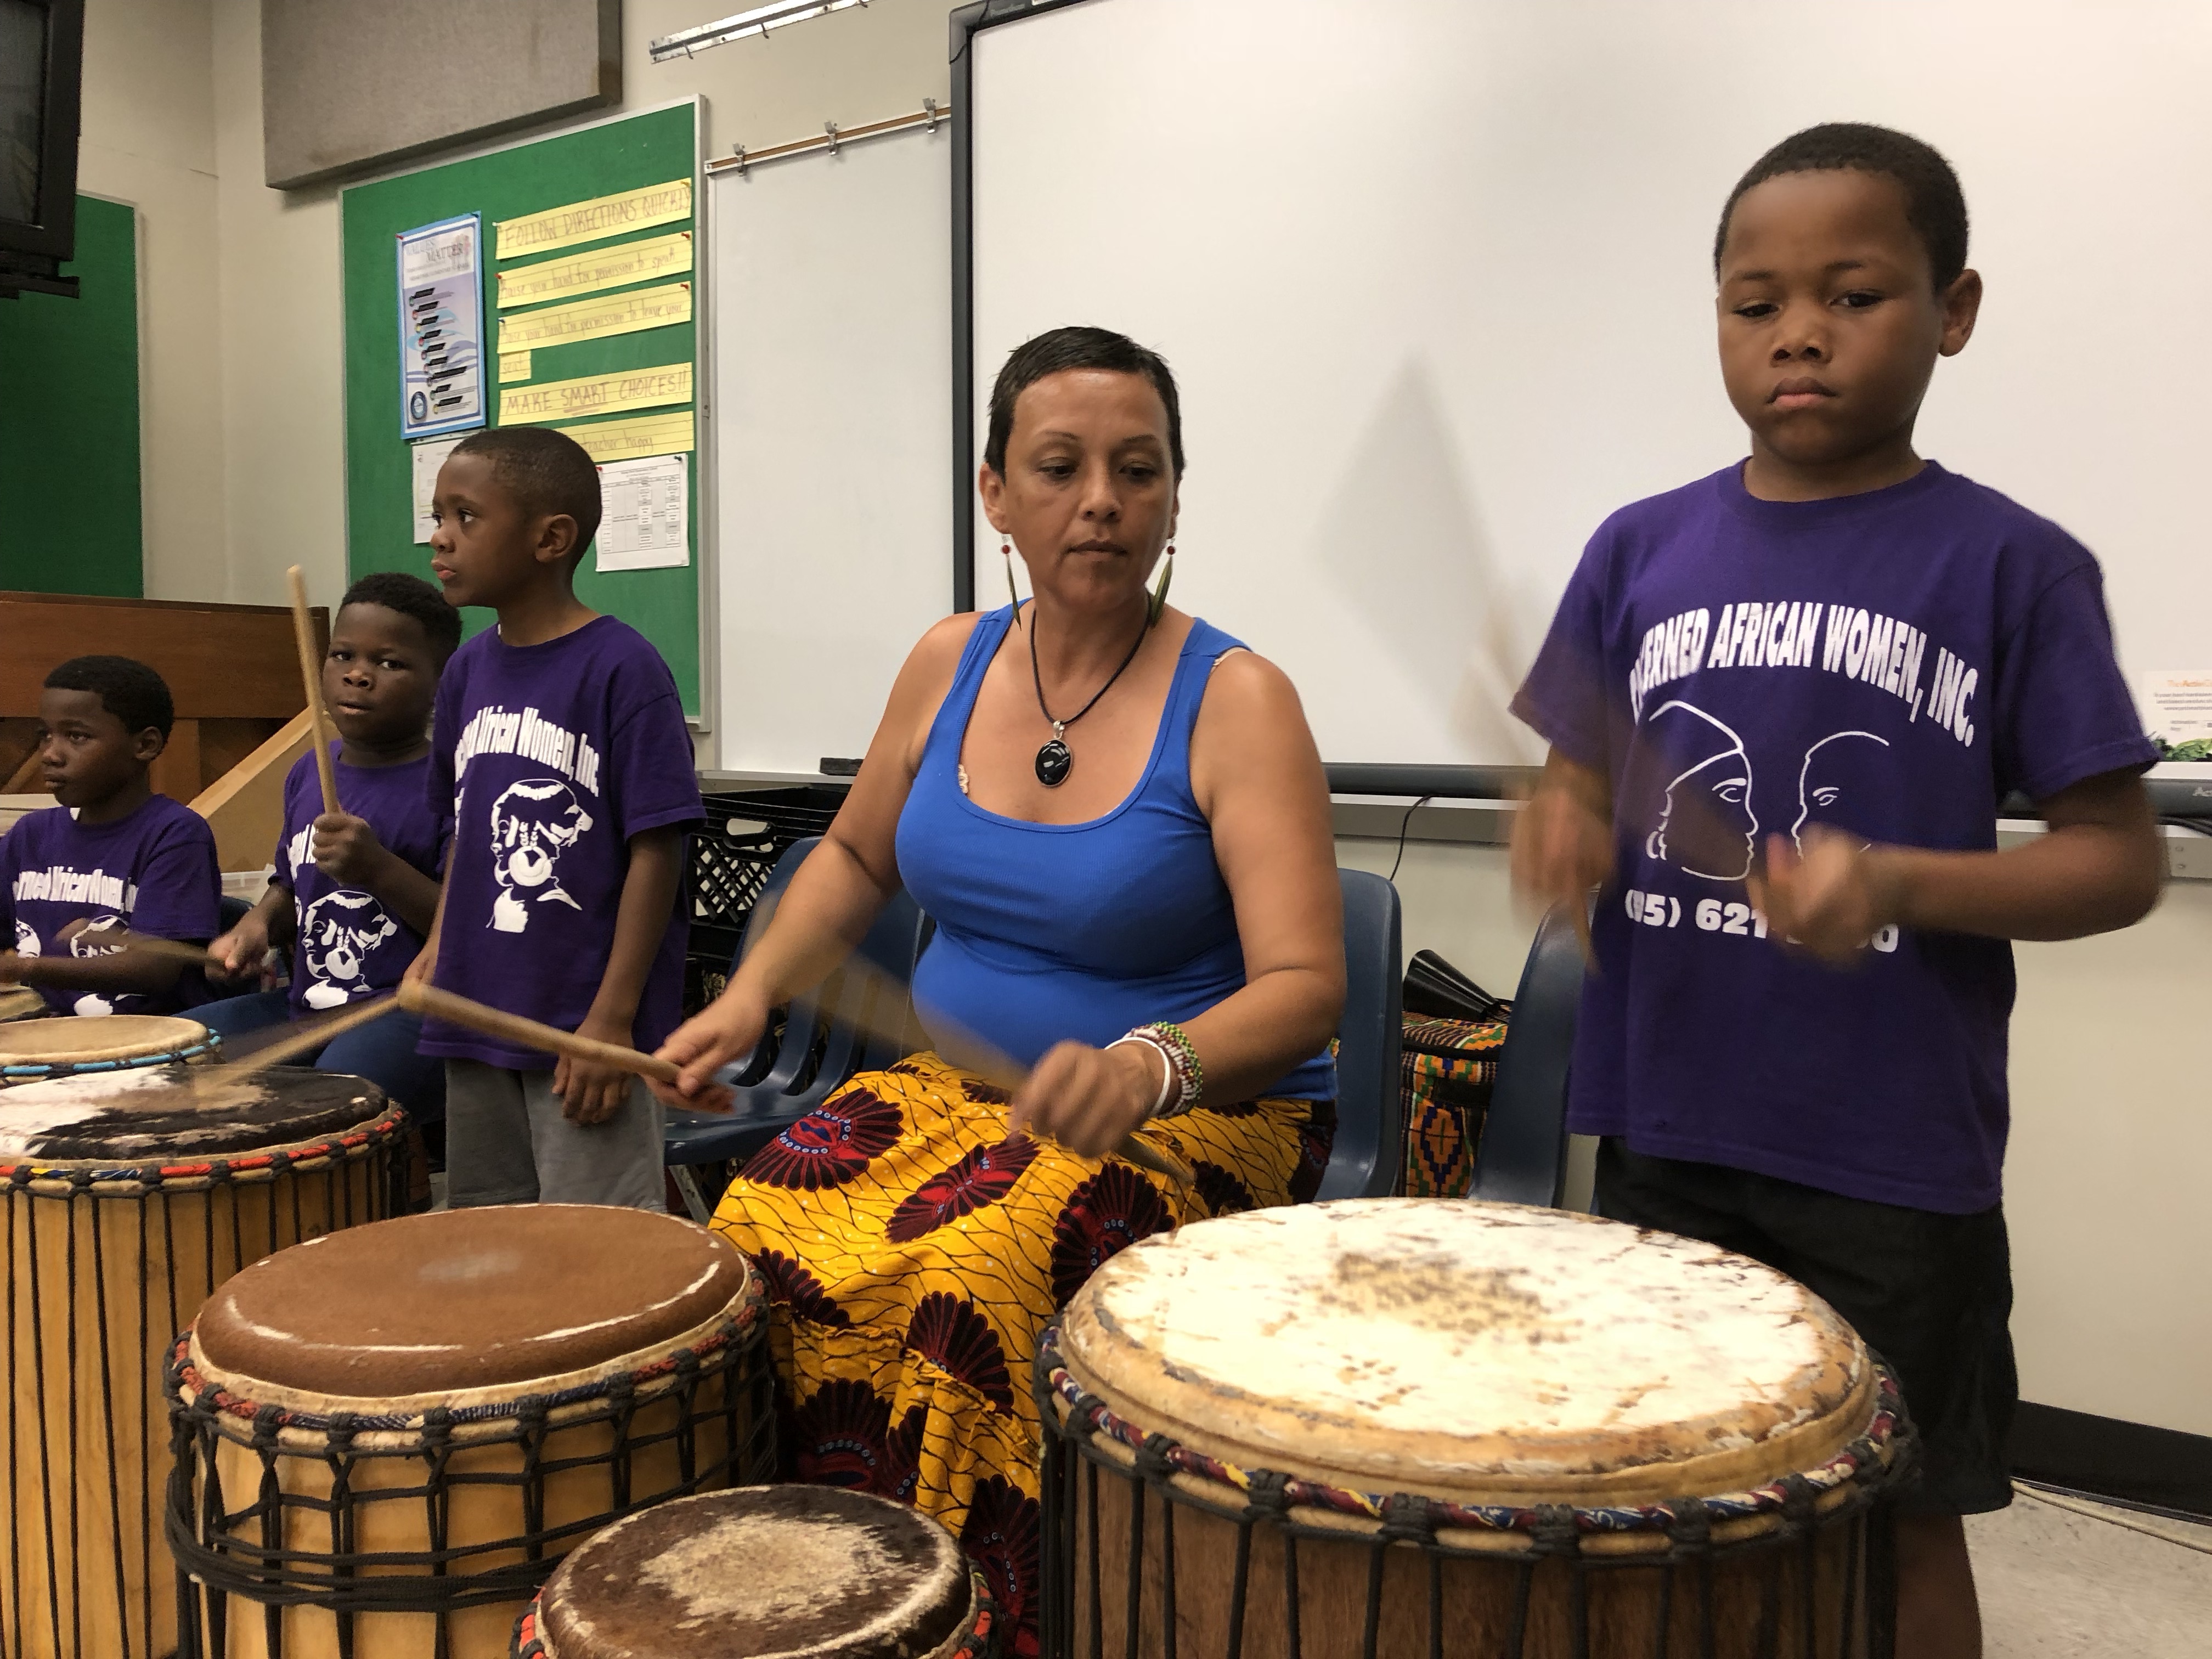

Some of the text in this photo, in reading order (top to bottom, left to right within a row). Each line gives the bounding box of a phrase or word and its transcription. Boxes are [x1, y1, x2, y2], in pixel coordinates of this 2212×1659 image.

[505, 187, 691, 250] FOLLOW DIRECTIONS QUICKLY
[505, 391, 553, 415] MAKE
[560, 381, 610, 407] SMART
[624, 430, 653, 454] happy
[1707, 601, 1823, 669] AFRICAN
[1822, 604, 1928, 723] WOMEN,
[1927, 646, 1978, 747] INC.
[516, 707, 575, 782] Women,
